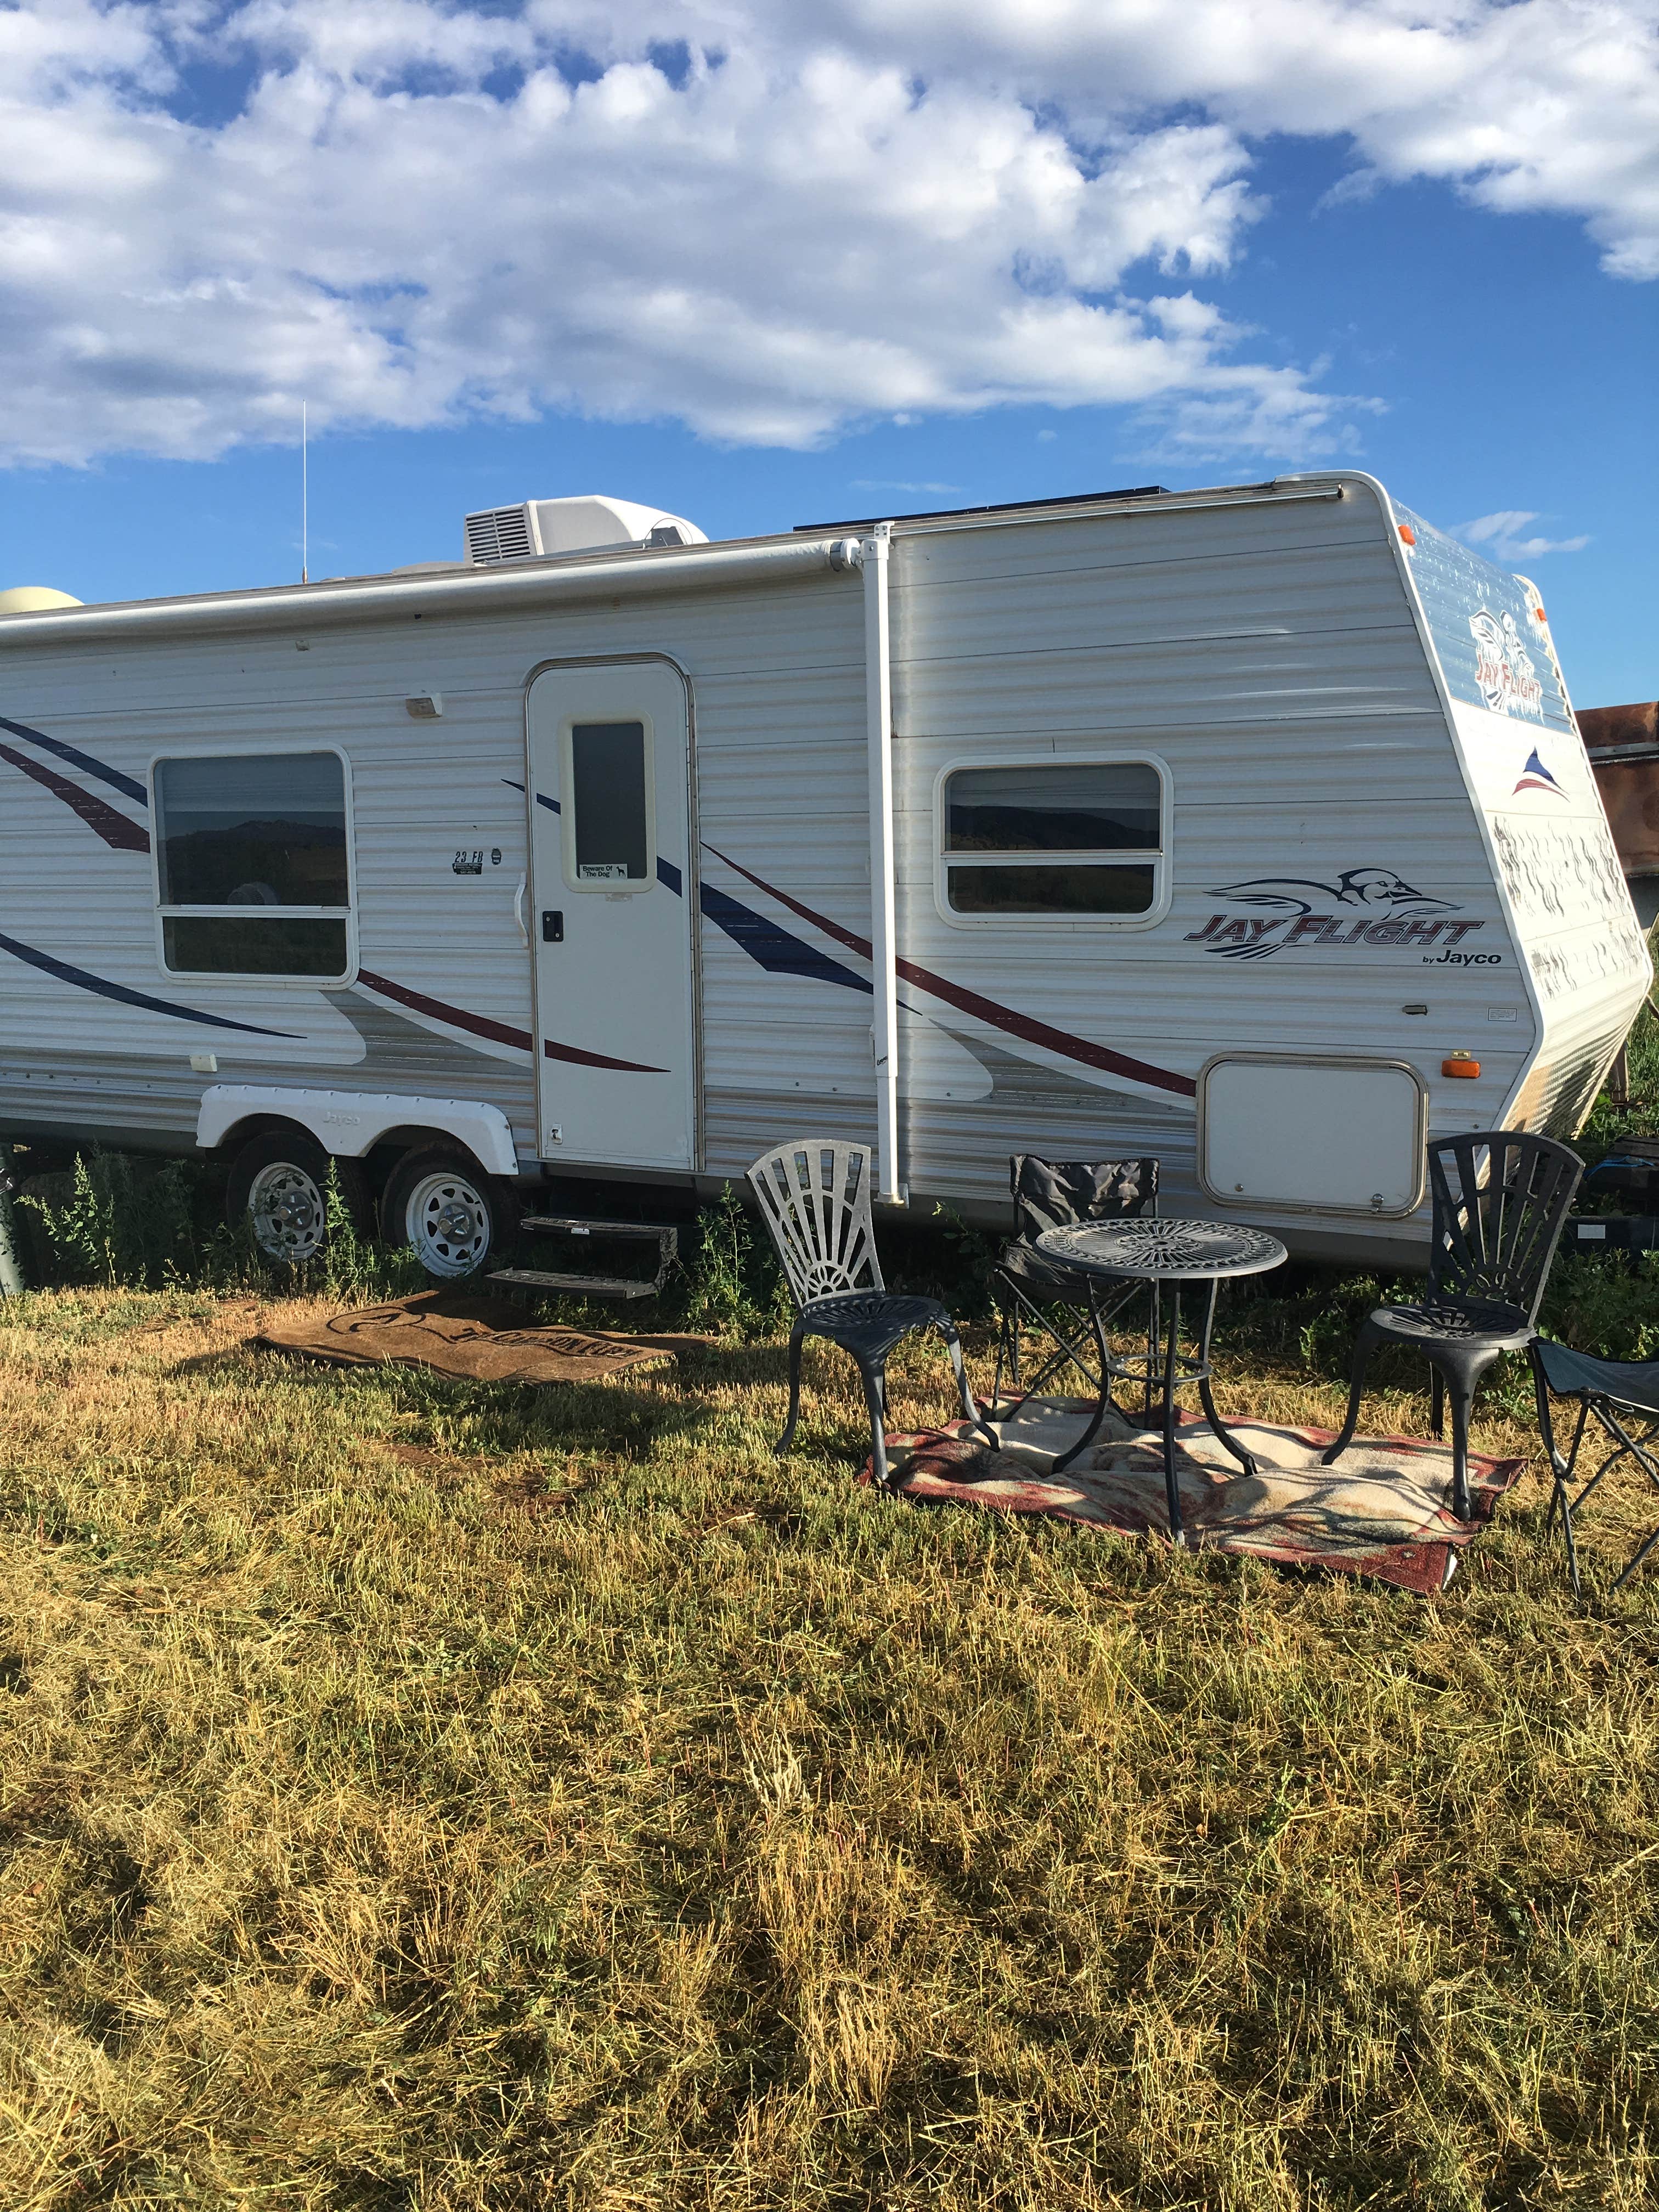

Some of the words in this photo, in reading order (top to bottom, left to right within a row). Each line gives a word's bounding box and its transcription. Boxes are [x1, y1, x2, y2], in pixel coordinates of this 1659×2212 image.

[1476, 652, 1498, 688] JAY
[1500, 661, 1541, 704] FLIGHT
[455, 851, 467, 862] 23
[472, 851, 483, 862] FB
[1183, 915, 1288, 942] JAY
[1282, 915, 1485, 945] FLIGHT
[1436, 950, 1502, 966] Jayco
